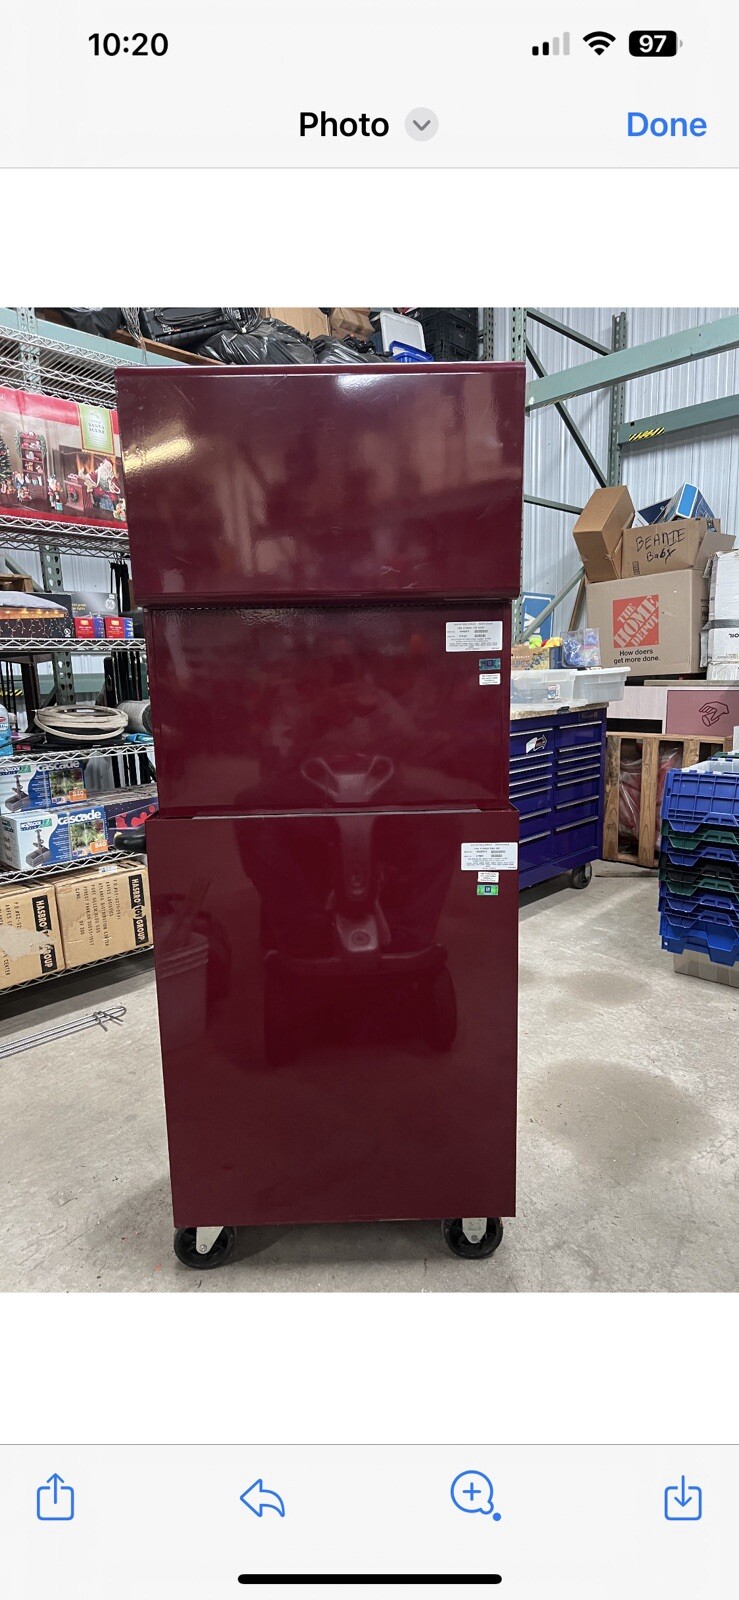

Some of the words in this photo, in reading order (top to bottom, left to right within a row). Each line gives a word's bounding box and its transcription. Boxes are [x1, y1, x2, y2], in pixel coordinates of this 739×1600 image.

[636, 528, 685, 552] BEANIE
[646, 548, 676, 564] Baby
[613, 595, 659, 648] HOME
[617, 602, 636, 623] THE
[630, 612, 659, 647] DEPOT
[613, 657, 624, 665] get
[37, 760, 80, 772] cascade
[57, 809, 102, 825] cascade
[131, 878, 141, 903] HASBRO
[36, 900, 47, 928] HASBRO
[134, 906, 143, 917] TOY
[136, 920, 146, 940] GROUP
